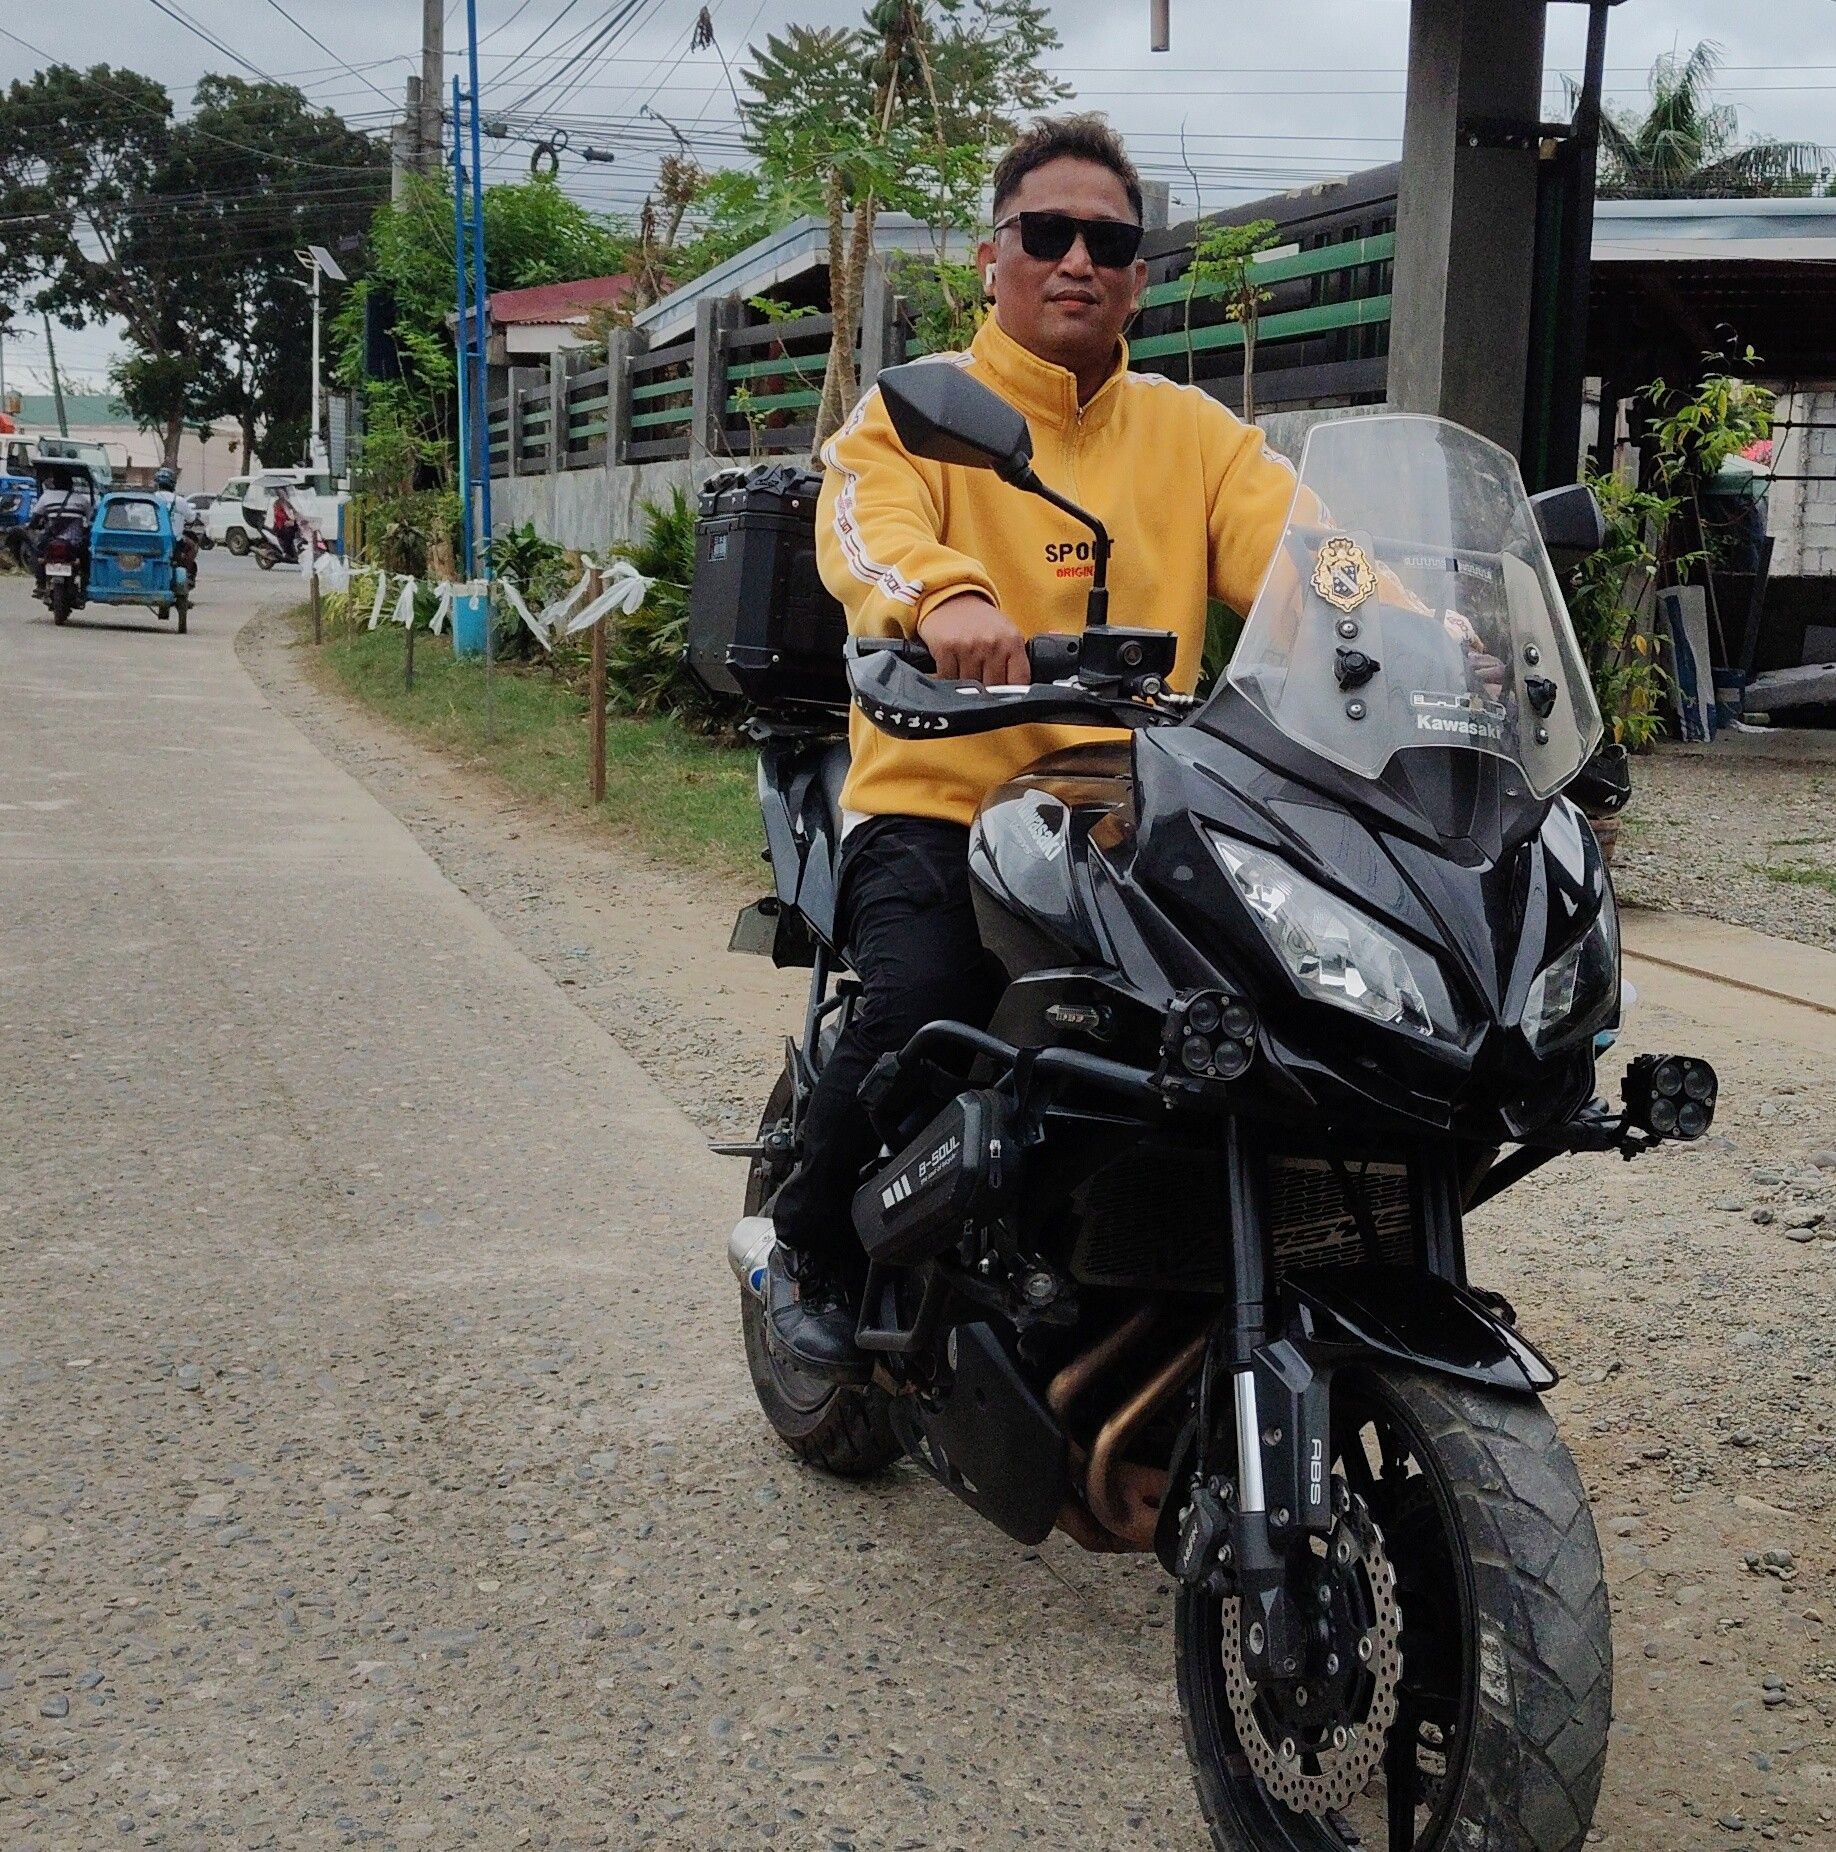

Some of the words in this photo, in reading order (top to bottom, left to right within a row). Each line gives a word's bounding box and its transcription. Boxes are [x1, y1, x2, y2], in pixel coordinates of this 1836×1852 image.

[1417, 714, 1503, 740] Kawasaki
[919, 1136, 960, 1178] B-SOUL
[1311, 1439, 1322, 1505] ABS
